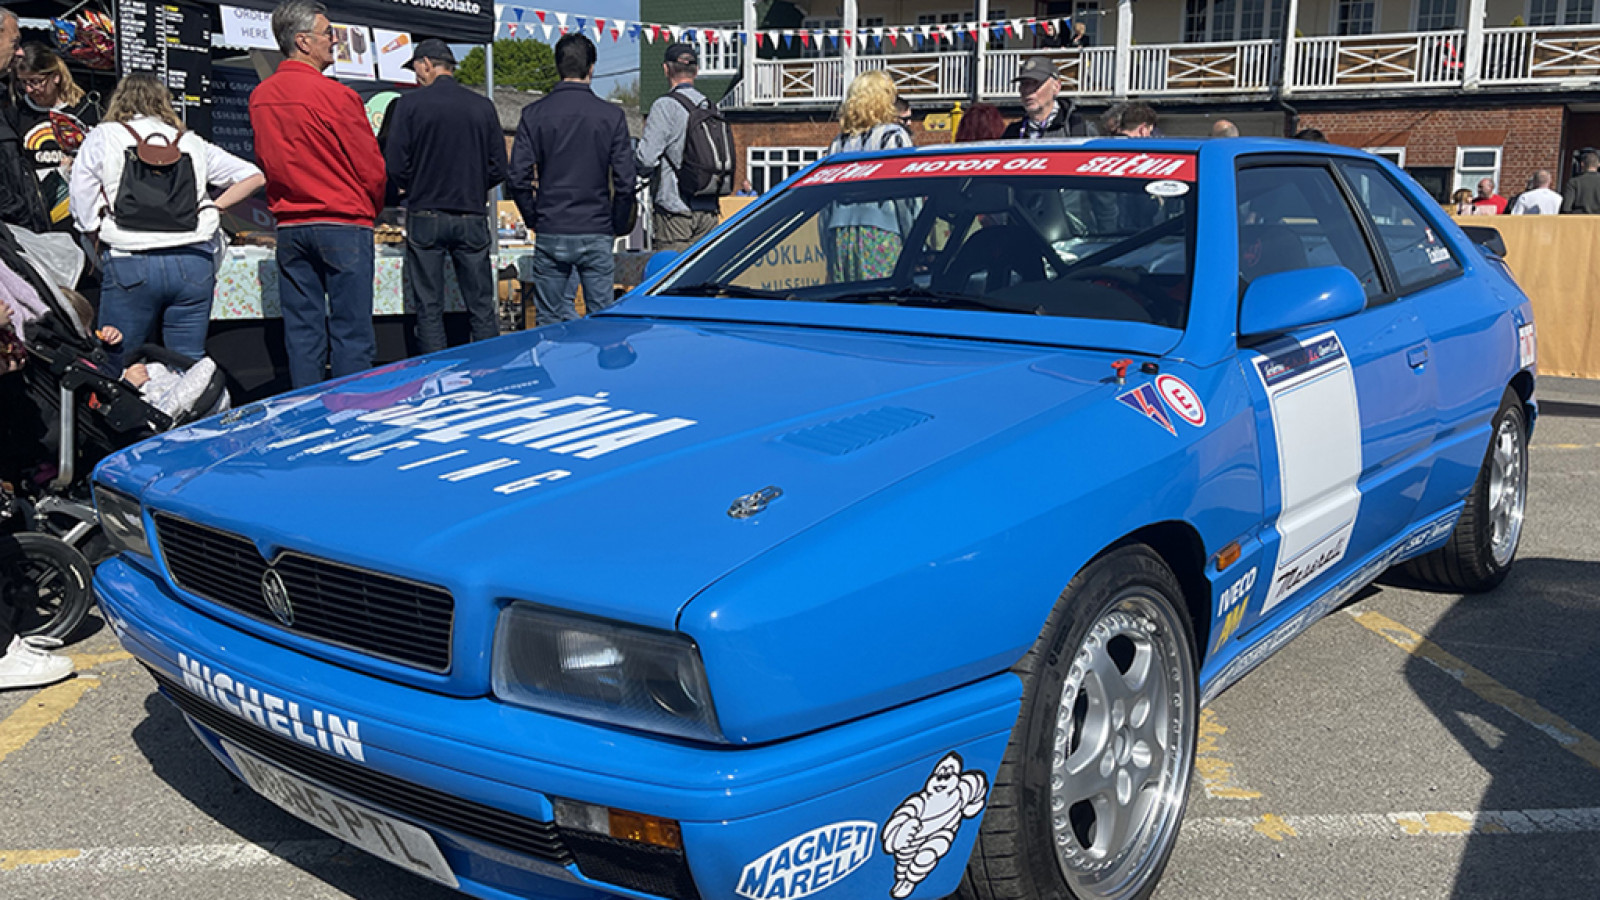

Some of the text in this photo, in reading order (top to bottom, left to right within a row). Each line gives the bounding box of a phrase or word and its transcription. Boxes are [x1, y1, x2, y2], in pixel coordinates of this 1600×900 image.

[241, 27, 269, 39] HERE
[900, 158, 1001, 173] MOTOR
[1003, 158, 1049, 170] OIL
[1217, 566, 1258, 618] IVECO
[178, 652, 365, 762] MICHELIN
[332, 799, 433, 871] PTL
